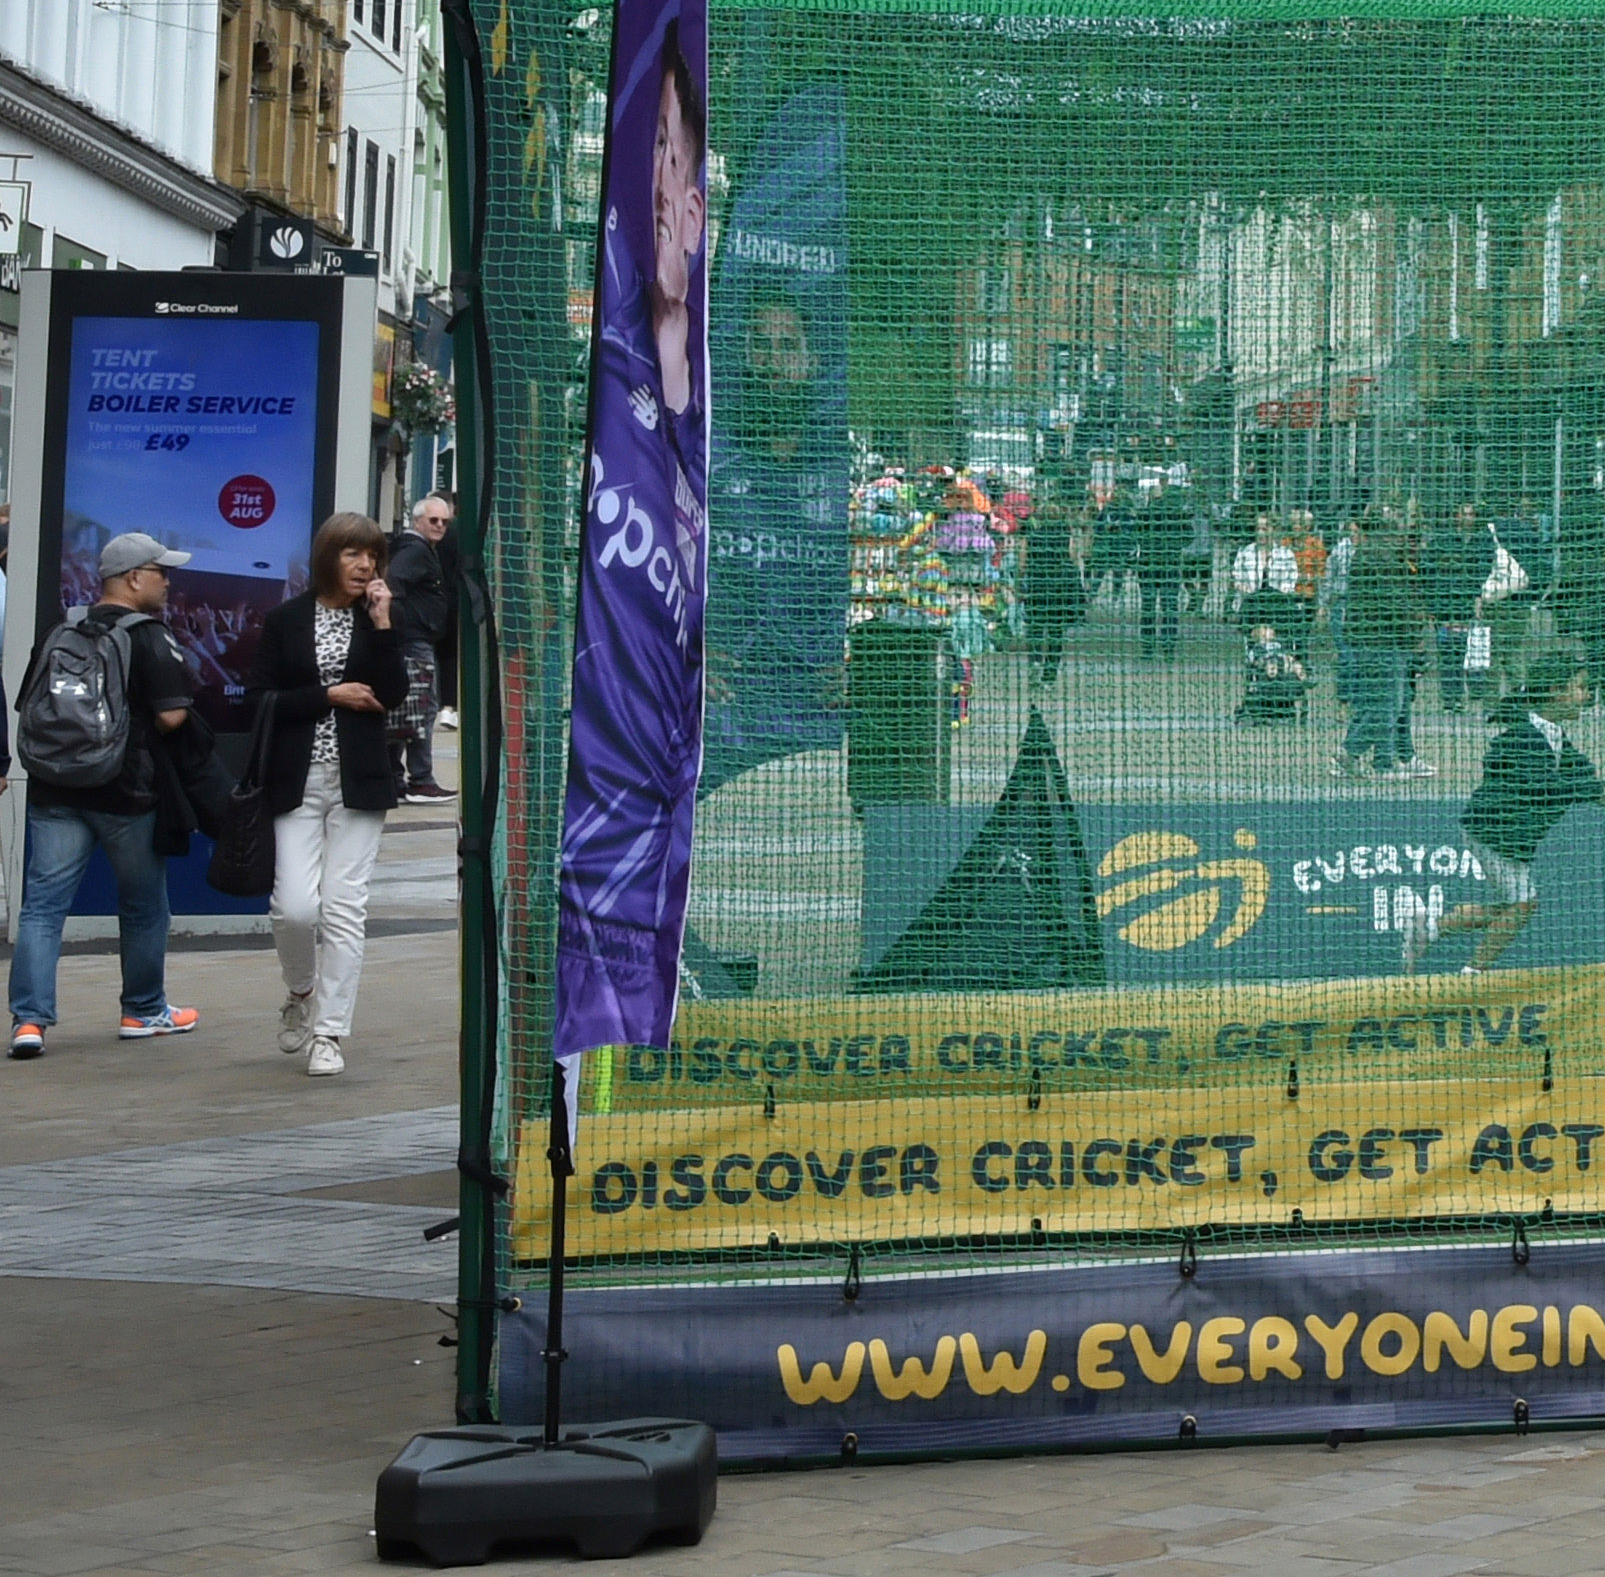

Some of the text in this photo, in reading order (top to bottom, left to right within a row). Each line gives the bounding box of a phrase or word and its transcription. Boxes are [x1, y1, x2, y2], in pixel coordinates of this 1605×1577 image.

[323, 251, 342, 268] To
[170, 302, 239, 314] Clear Channel
[91, 349, 158, 366] TENT
[91, 372, 196, 391] TICKETS
[87, 394, 296, 415] BOILER SERVICE
[145, 433, 191, 452] £49
[232, 494, 262, 505] 31st
[230, 507, 264, 519] AUG
[627, 1033, 910, 1083] DISCOVER
[1214, 1021, 1313, 1062] GET
[1347, 1003, 1549, 1055] ACTIVE
[591, 1141, 940, 1214] DISCOVER
[971, 1134, 1277, 1196] CRICKET,
[1307, 1128, 1444, 1182] GET
